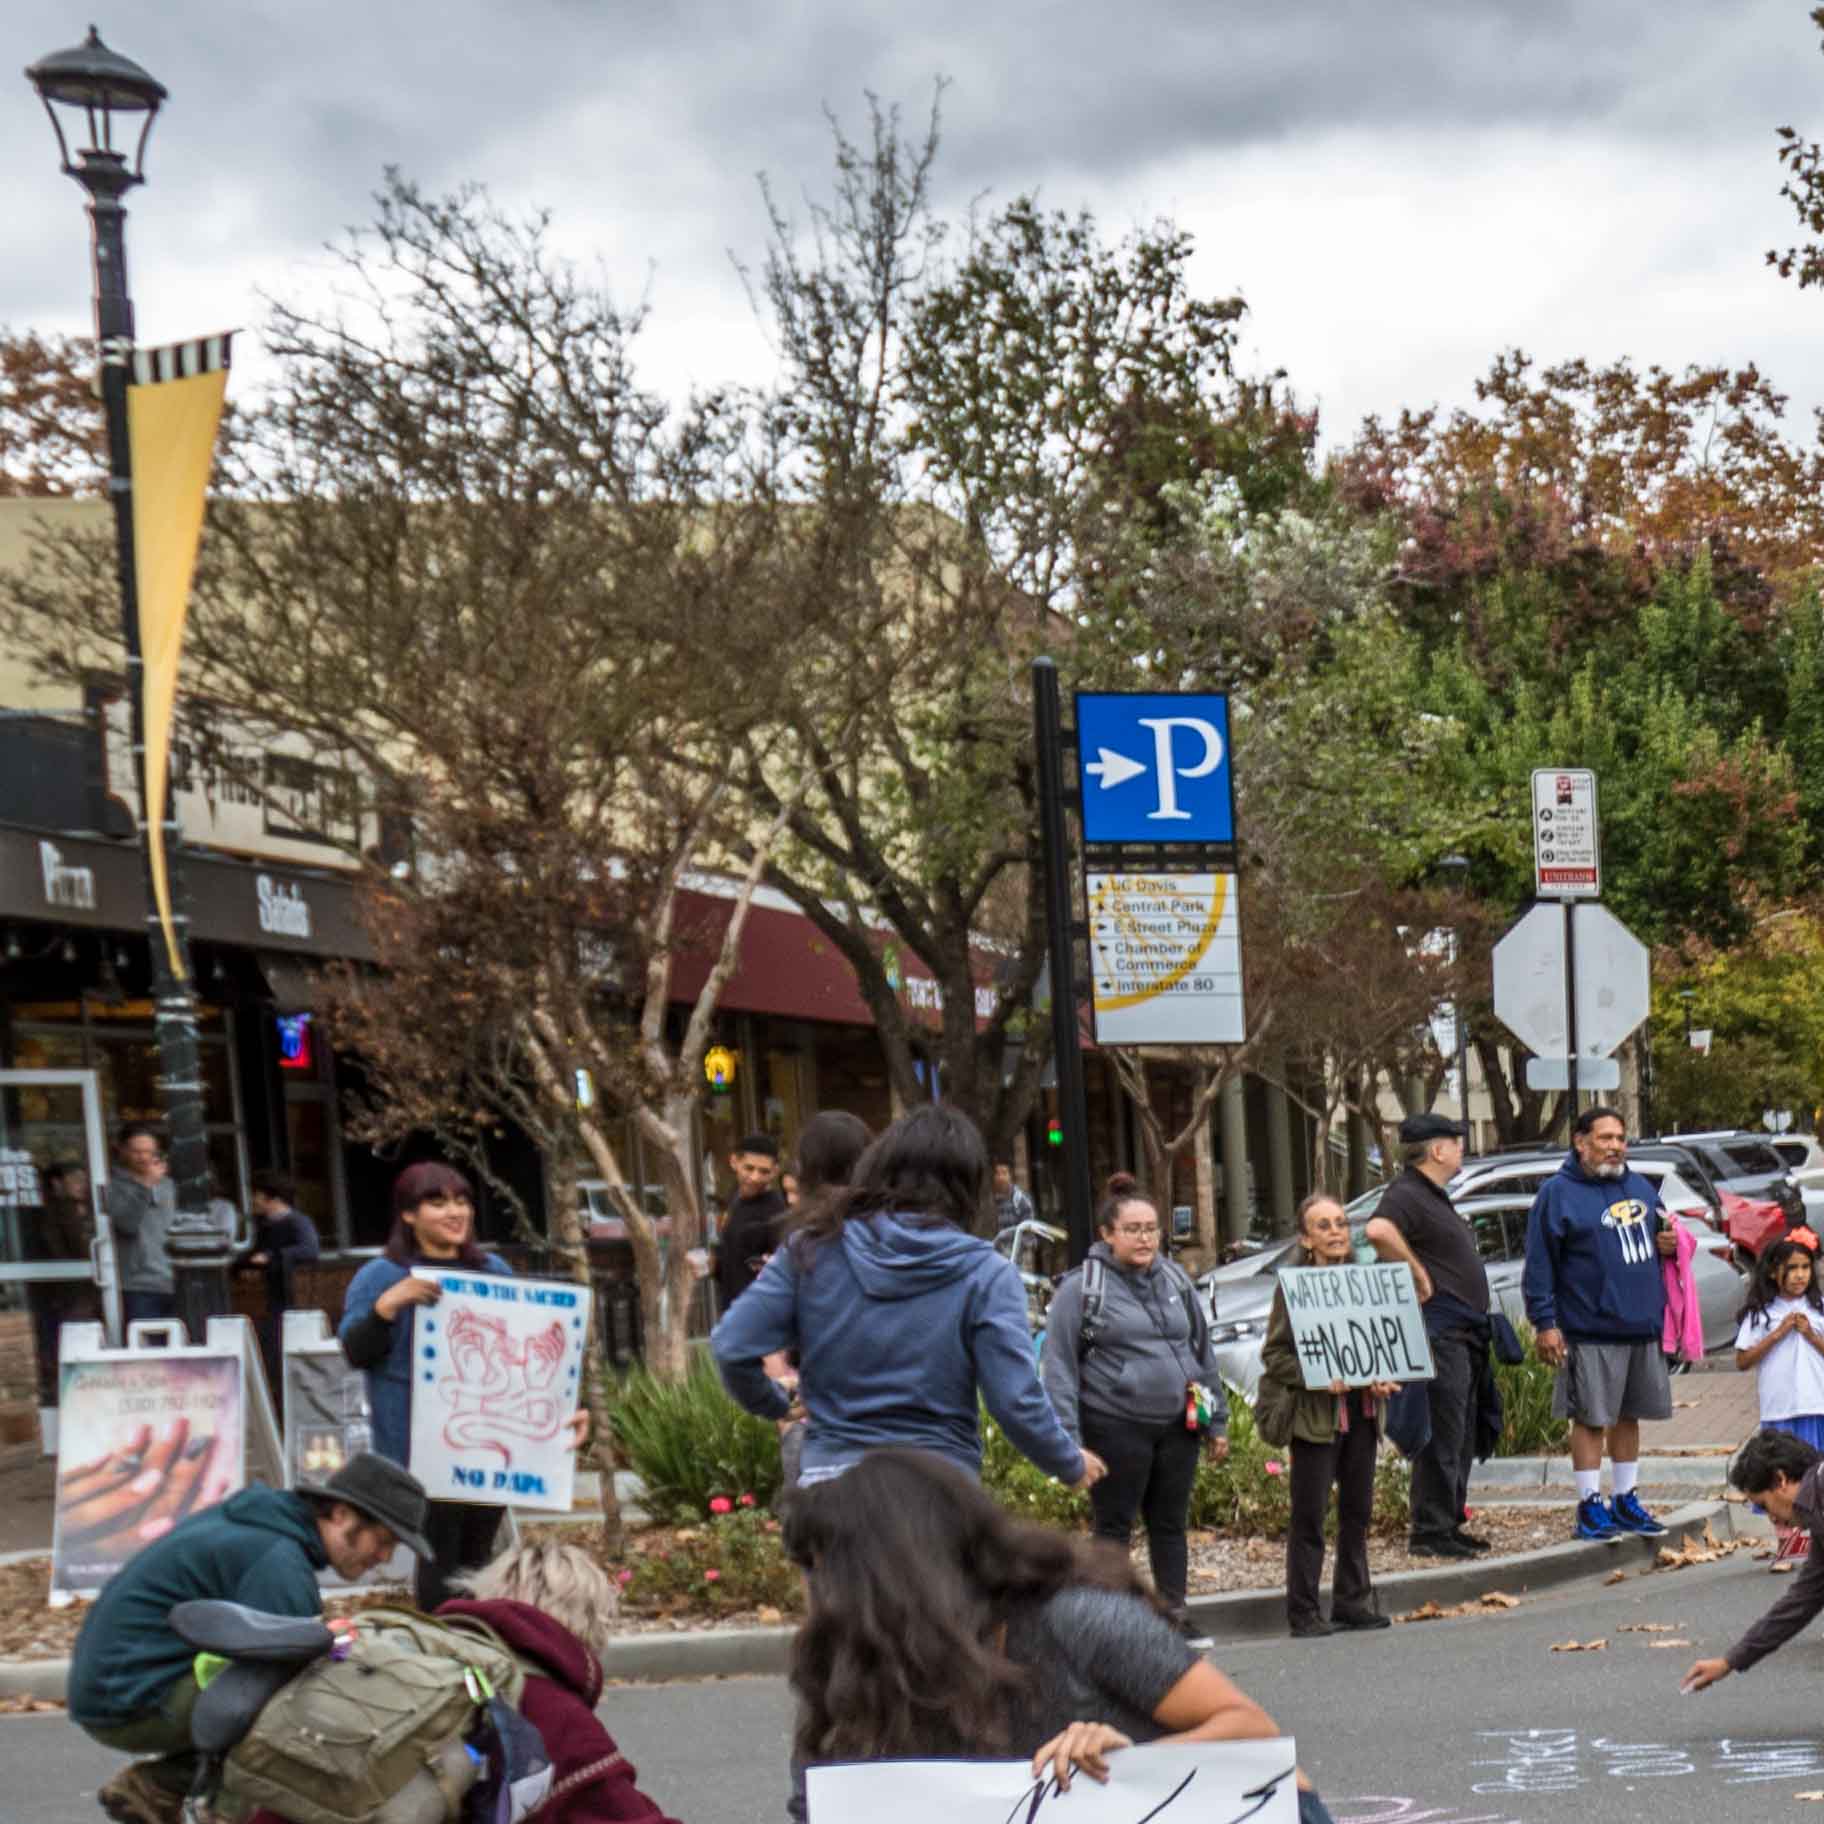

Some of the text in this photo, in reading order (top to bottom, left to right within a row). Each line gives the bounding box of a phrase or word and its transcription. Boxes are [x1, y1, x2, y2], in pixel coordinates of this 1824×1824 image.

[1137, 717, 1224, 820] P
[1136, 880, 1177, 891] Davis
[1112, 900, 1205, 912] Central Park
[1114, 921, 1217, 933] E Street Plaza
[1115, 942, 1183, 954] Chamber
[1116, 959, 1197, 970] Commerce
[1118, 978, 1214, 991] Interstate 80
[1281, 1267, 1411, 1309] WATER IS LIFE
[452, 1465, 548, 1497] NO DAPL
